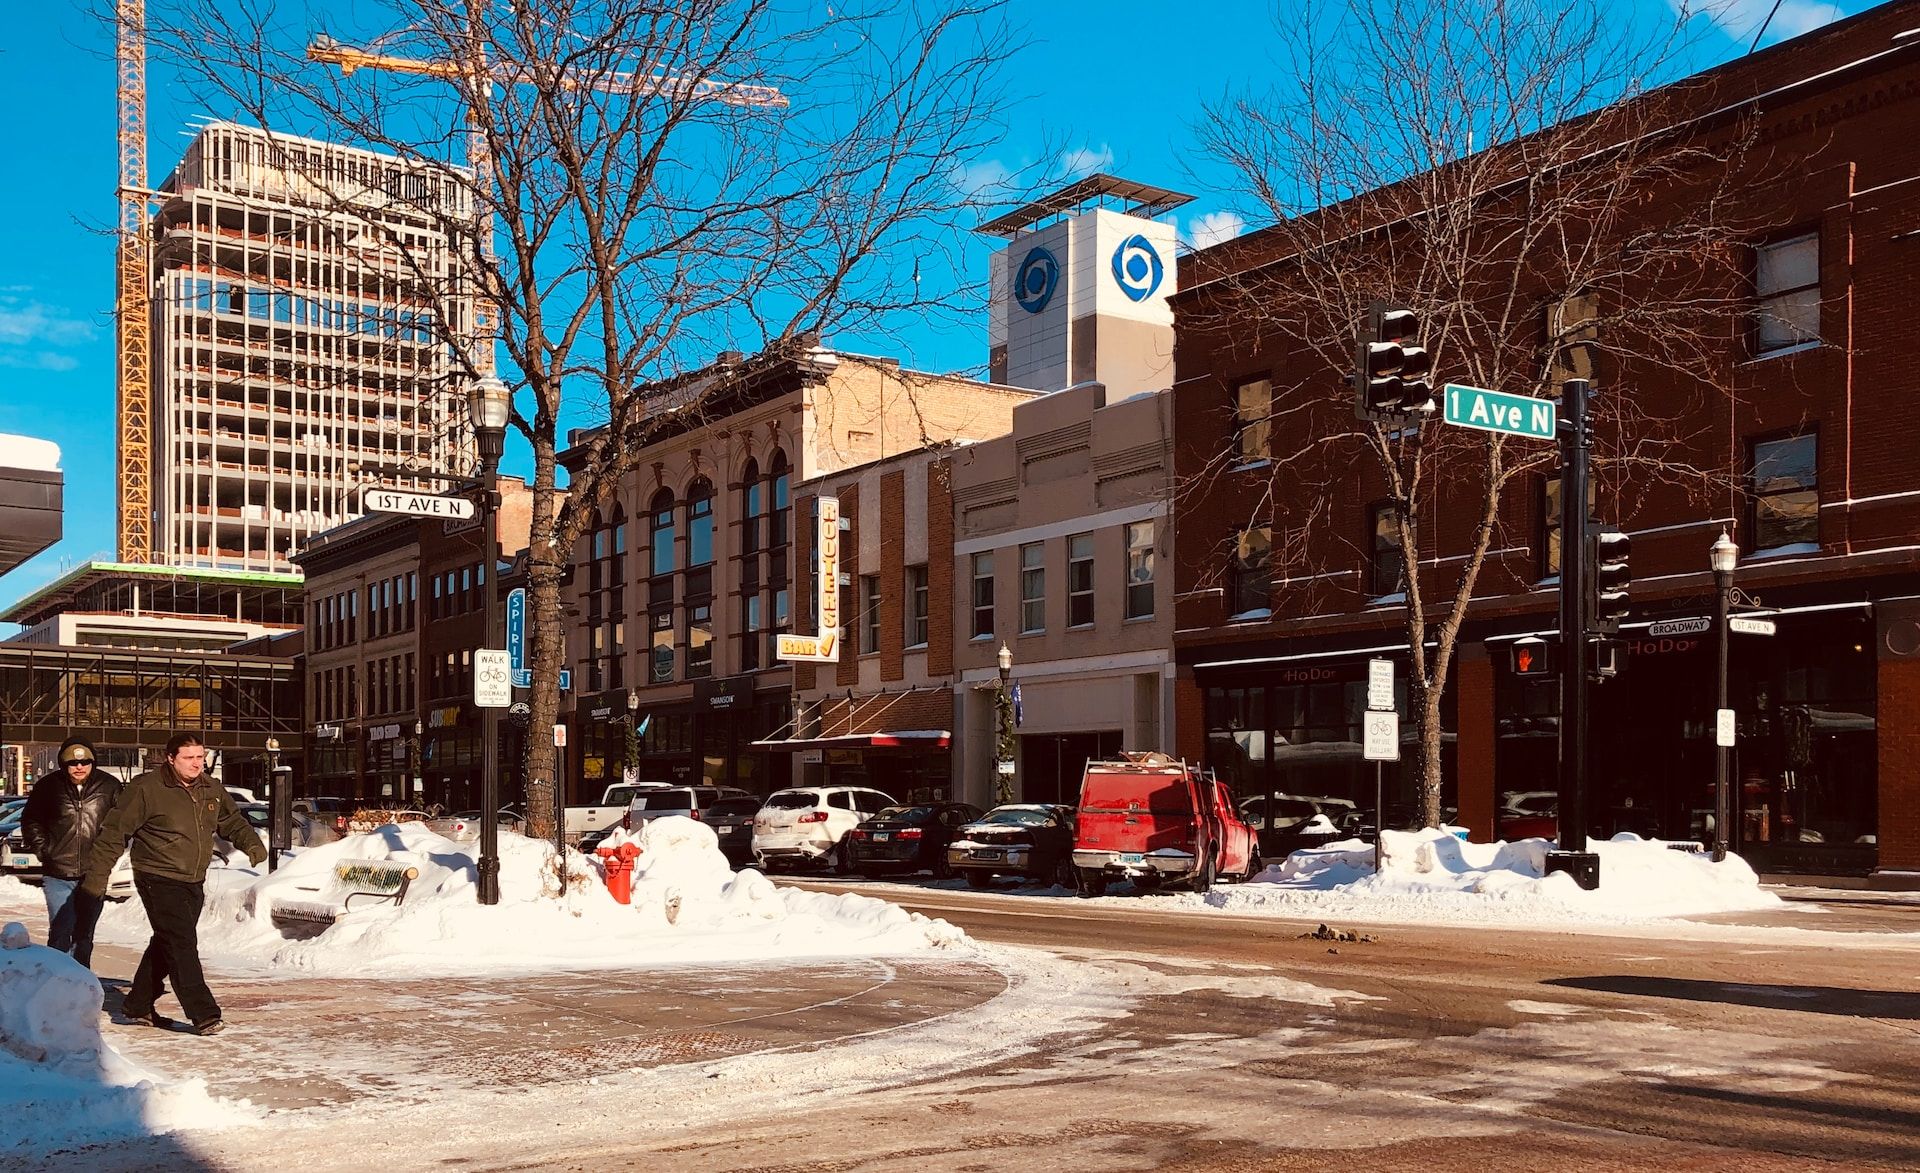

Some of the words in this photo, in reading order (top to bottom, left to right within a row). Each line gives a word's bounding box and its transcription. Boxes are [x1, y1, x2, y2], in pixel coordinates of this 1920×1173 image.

[1451, 391, 1459, 419] 1
[1469, 395, 1523, 429] Ave
[1531, 404, 1549, 433] N
[378, 495, 402, 509] 1ST
[408, 498, 441, 513] AVE
[450, 501, 461, 515] N
[822, 502, 836, 628] ROOTERS
[511, 597, 520, 668] SPIRIT
[1653, 621, 1705, 634] BROADWAY
[1734, 620, 1745, 630] 1ST
[1747, 622, 1761, 631] AVE
[1763, 624, 1770, 632] N
[781, 638, 816, 656] BAR
[481, 656, 504, 665] WALK
[429, 706, 460, 728] SUBWAY
